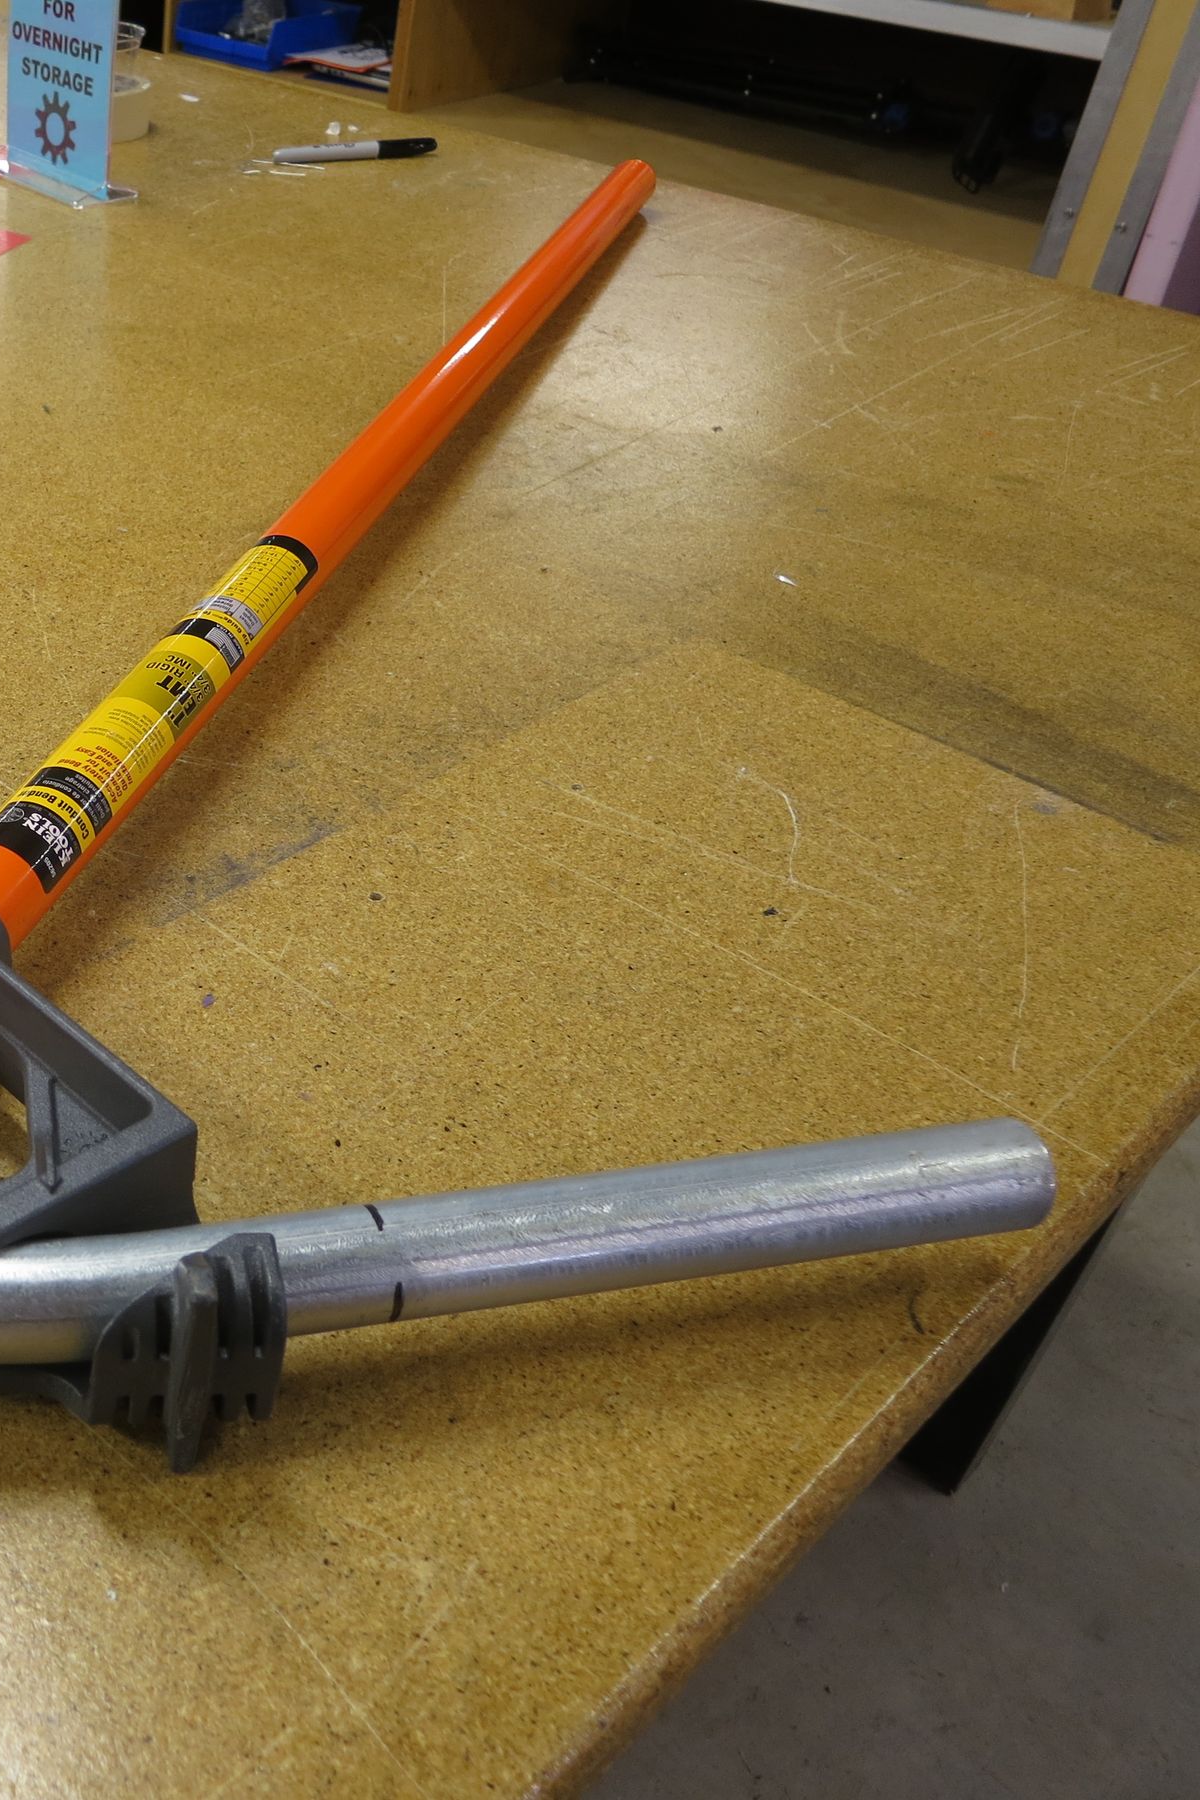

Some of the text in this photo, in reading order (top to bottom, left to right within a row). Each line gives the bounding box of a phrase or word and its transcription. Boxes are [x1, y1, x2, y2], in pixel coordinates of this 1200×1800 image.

[43, 0, 75, 22] FOR
[12, 21, 102, 64] OVERNIGHT
[22, 57, 94, 96] STORAGE
[146, 661, 185, 679] RIGID
[164, 654, 192, 670] IMC
[155, 674, 197, 717] EMT
[74, 746, 97, 758] Easy
[95, 754, 113, 768] and
[17, 789, 58, 805] Bendr
[56, 798, 91, 841] Conduit
[22, 818, 70, 868] KLEIN
[29, 812, 74, 863] TOOLS
